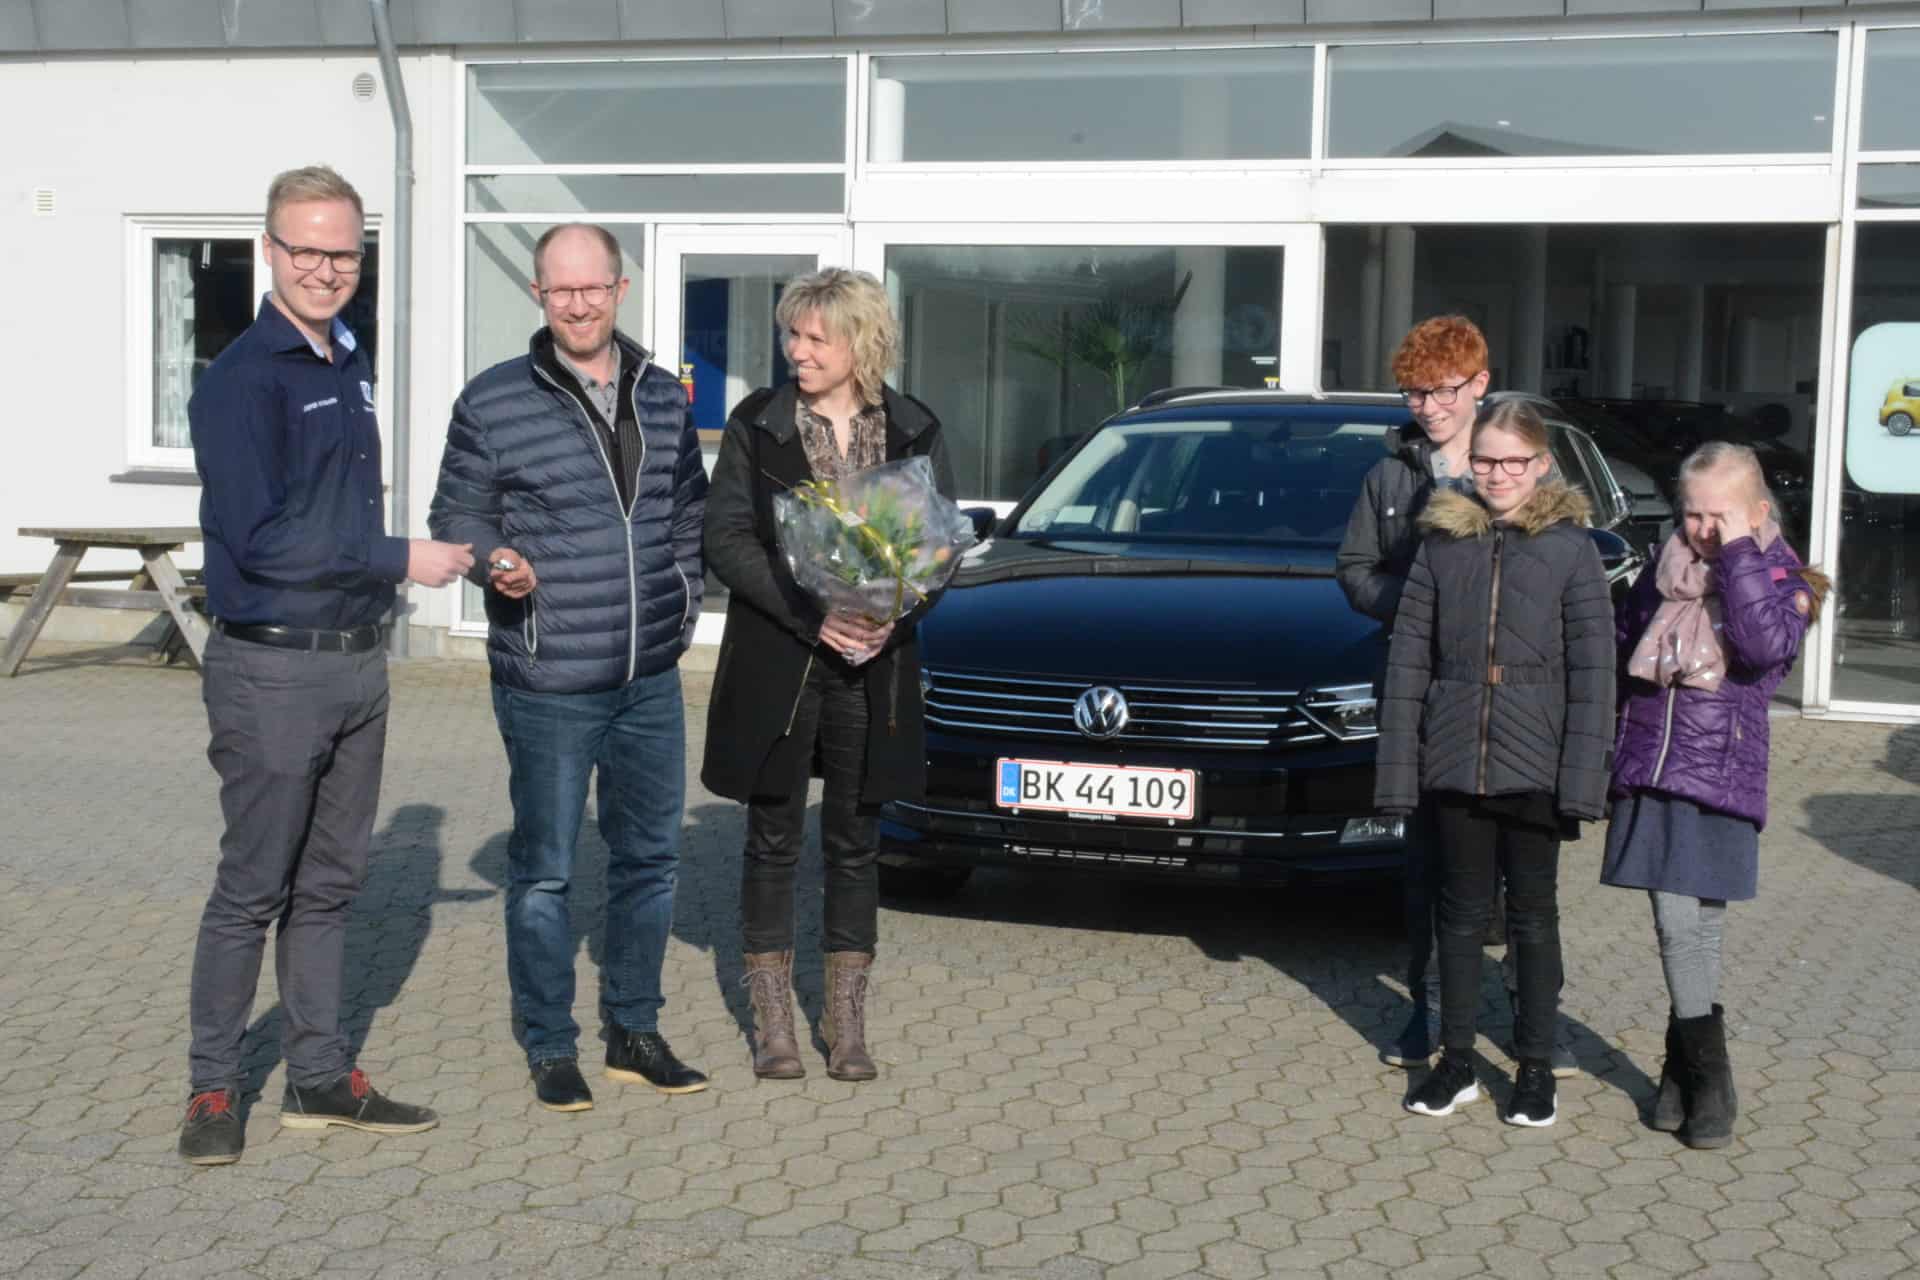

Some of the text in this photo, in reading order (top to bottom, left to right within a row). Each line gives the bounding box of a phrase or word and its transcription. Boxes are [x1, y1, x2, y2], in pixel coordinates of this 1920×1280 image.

[1074, 686, 1128, 738] VW
[1002, 786, 1016, 798] DK
[1022, 769, 1187, 810] BK 44 109
